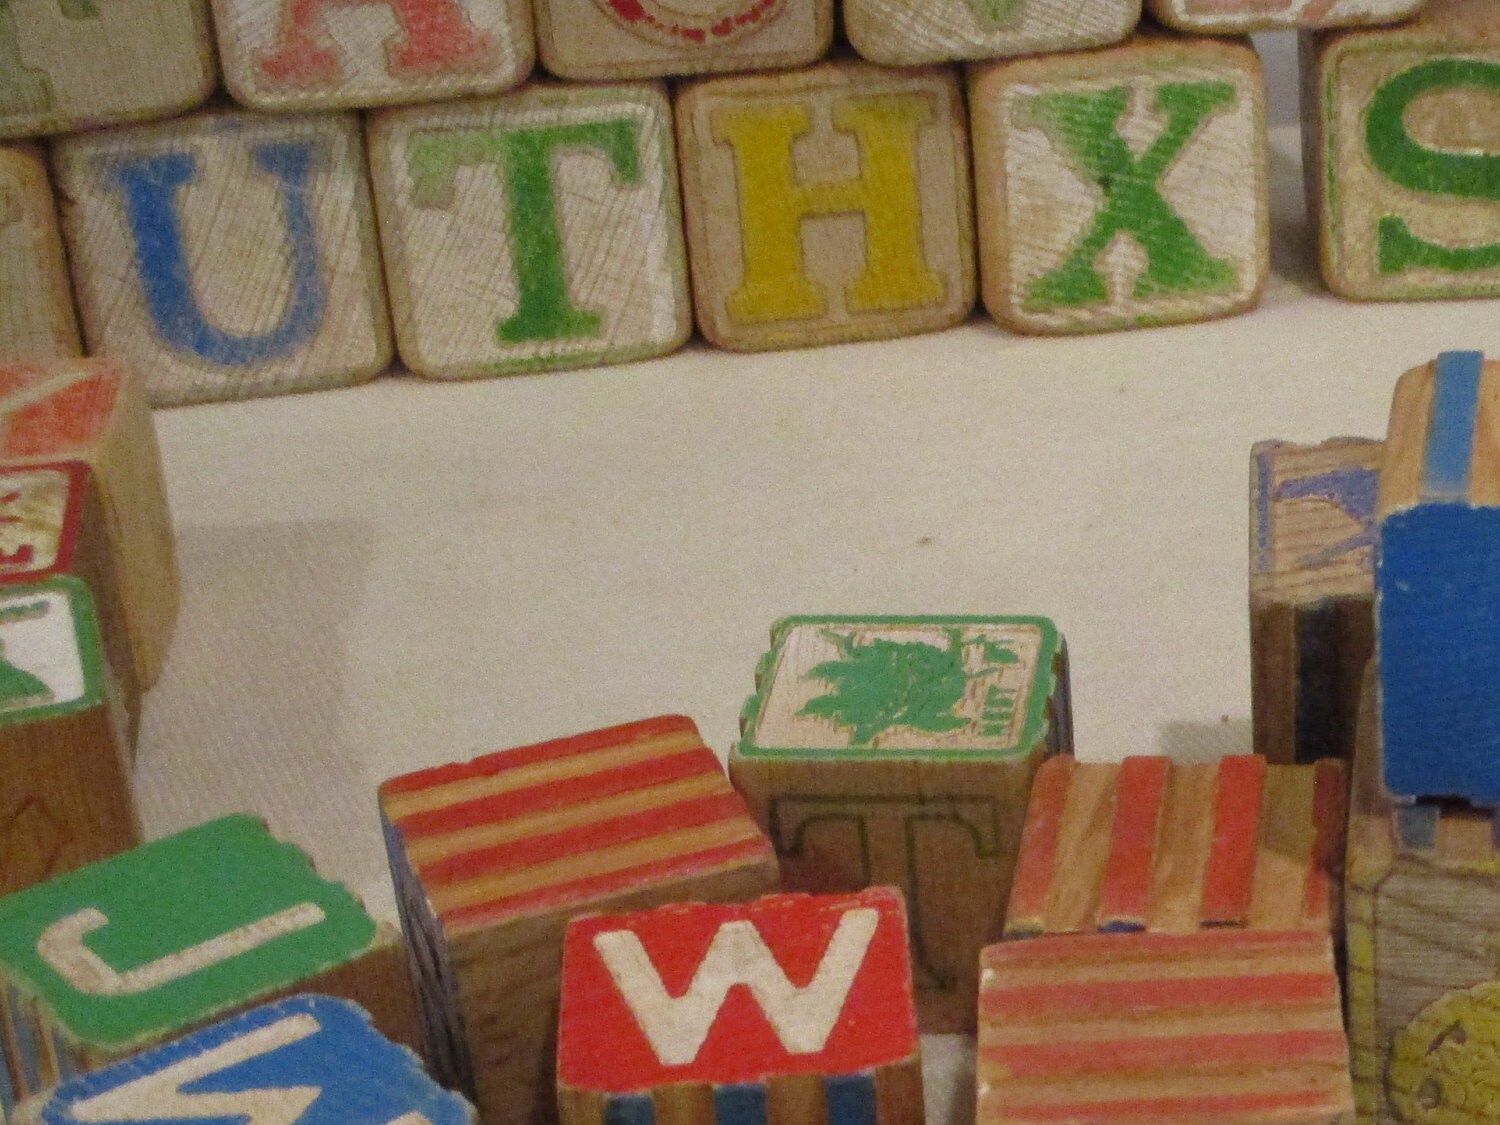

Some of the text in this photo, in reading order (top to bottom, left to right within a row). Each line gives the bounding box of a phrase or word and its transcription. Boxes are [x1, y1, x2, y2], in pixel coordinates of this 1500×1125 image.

[98, 141, 339, 366] U
[407, 118, 643, 346] T
[709, 91, 946, 325] H
[1009, 80, 1240, 312] X
[36, 901, 326, 997] J
[592, 907, 880, 1066] W
